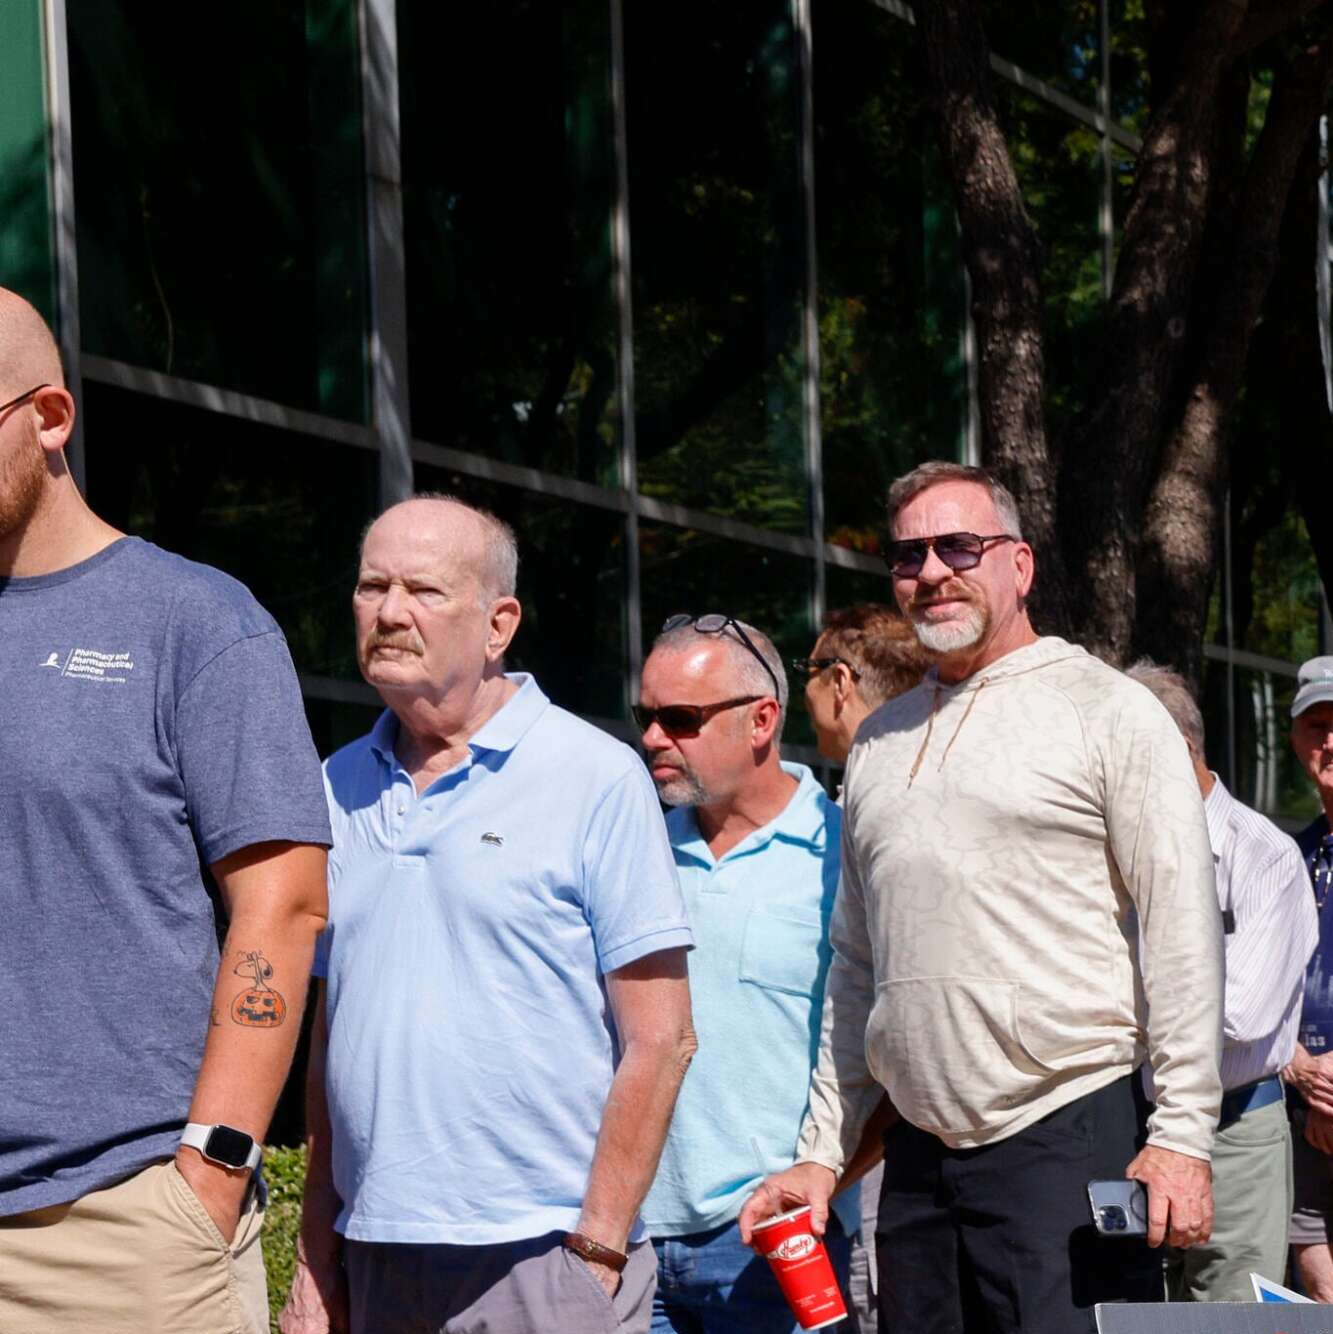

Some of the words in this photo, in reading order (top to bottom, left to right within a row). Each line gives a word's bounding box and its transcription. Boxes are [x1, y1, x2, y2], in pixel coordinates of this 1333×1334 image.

[74, 647, 115, 661] Pharmacy
[115, 651, 130, 660] and
[67, 663, 105, 675] Sciences
[71, 655, 134, 672] Pharmaceutical
